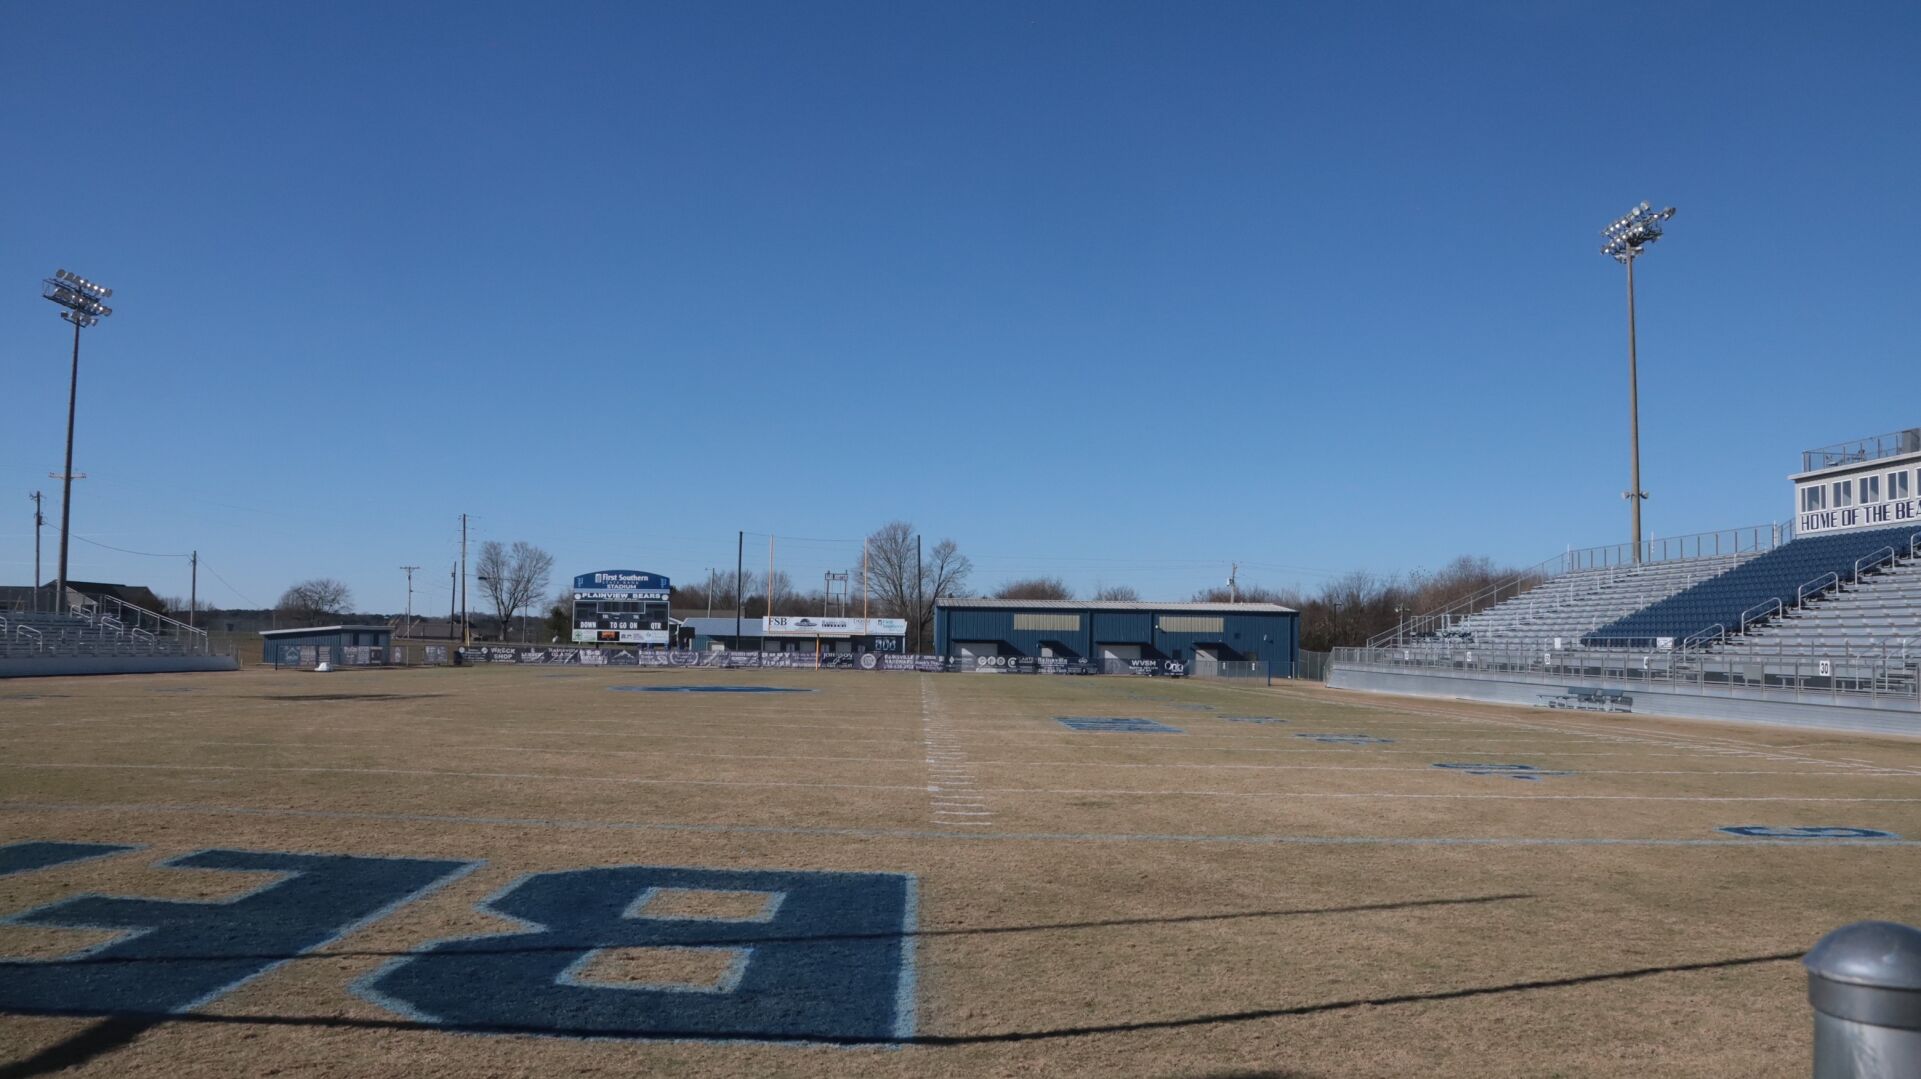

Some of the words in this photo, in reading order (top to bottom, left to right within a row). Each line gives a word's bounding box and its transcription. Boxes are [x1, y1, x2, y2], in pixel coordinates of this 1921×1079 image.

[1801, 512, 1838, 531] HOME
[1842, 508, 1859, 526] OF
[1864, 504, 1890, 524] THE
[602, 573, 617, 581] First
[610, 621, 617, 629] TO
[769, 617, 787, 626] FSB
[650, 622, 662, 630] QTR
[1821, 663, 1829, 674] 30
